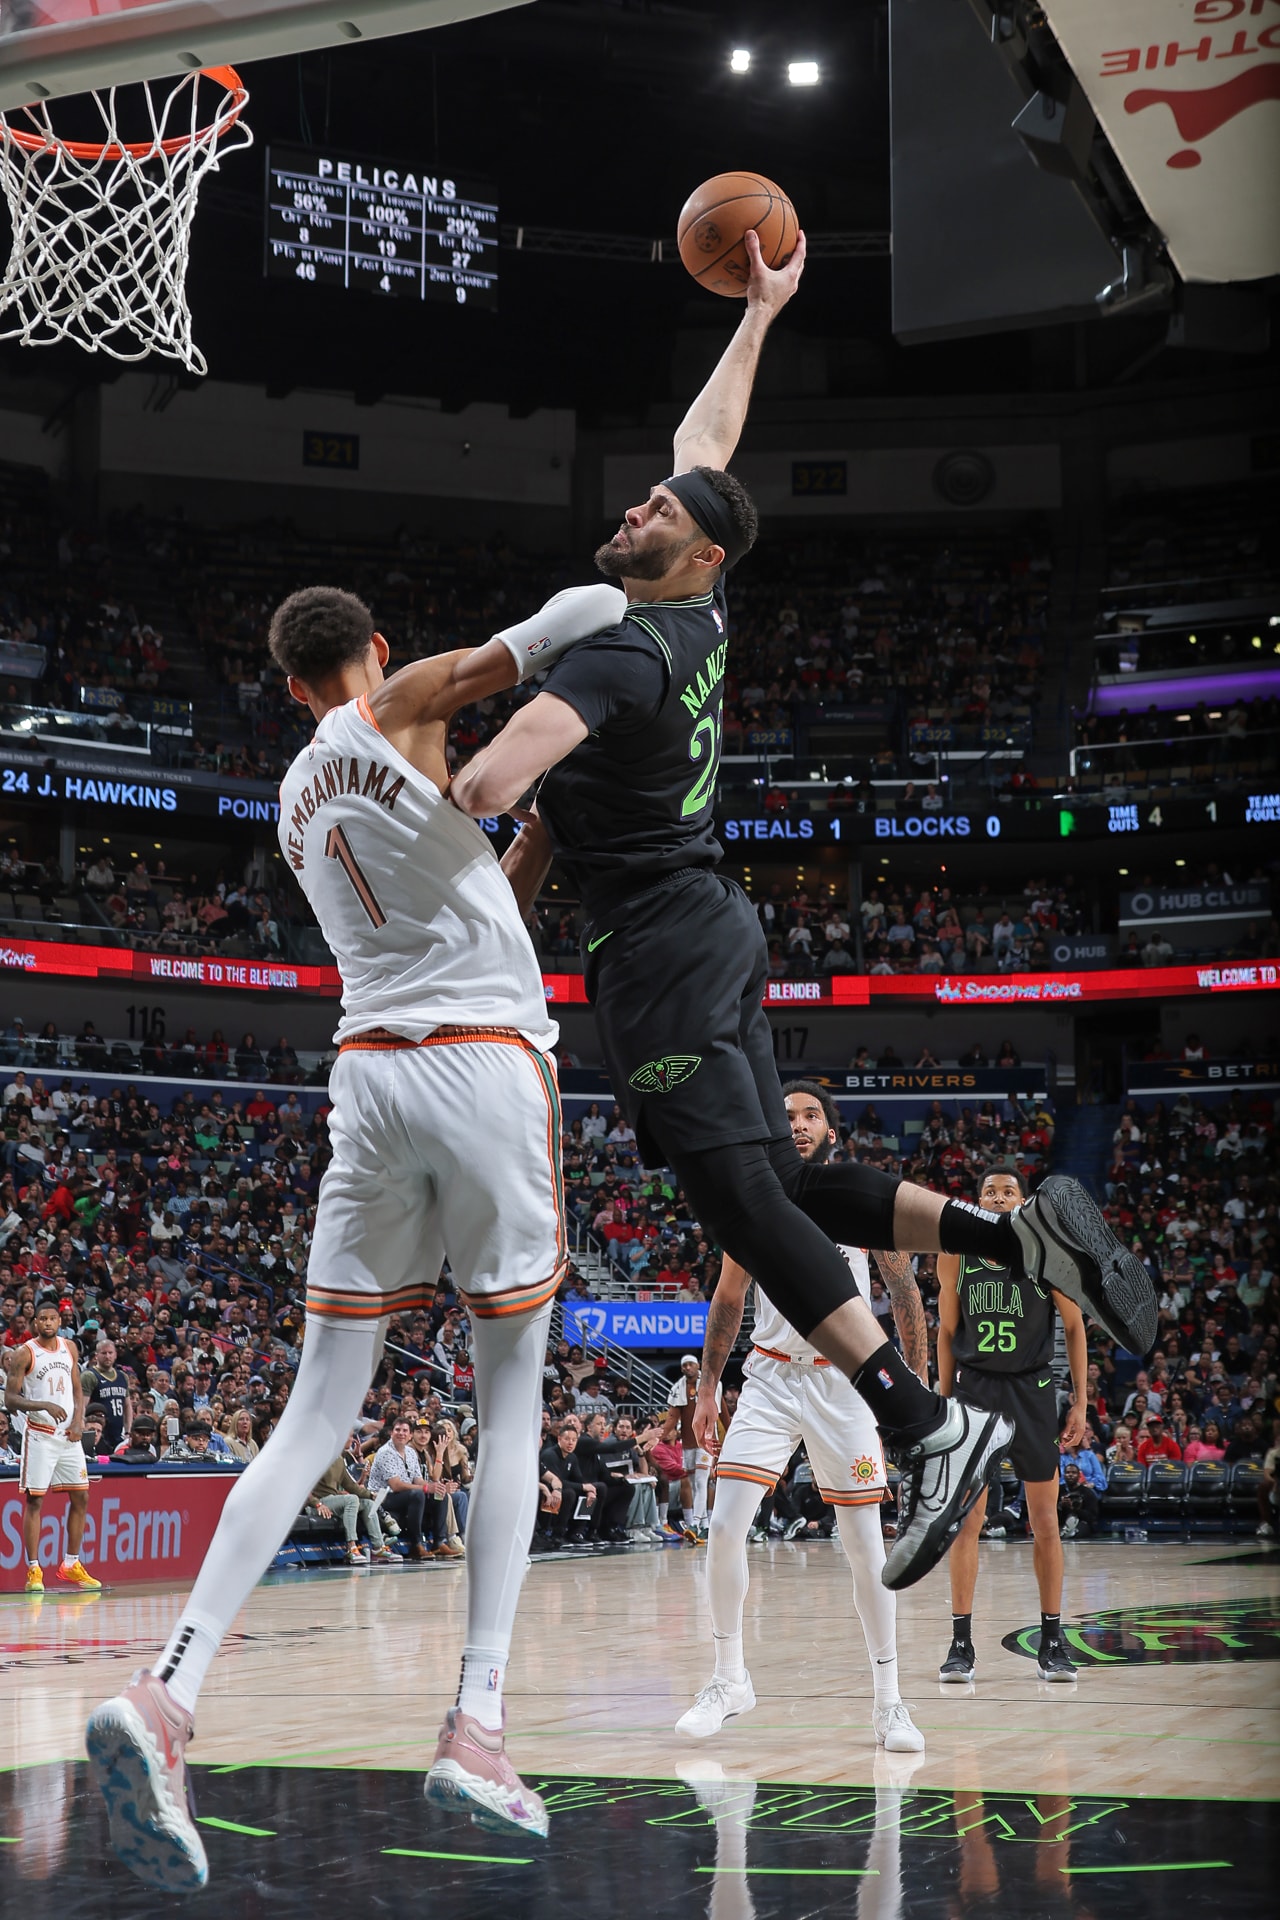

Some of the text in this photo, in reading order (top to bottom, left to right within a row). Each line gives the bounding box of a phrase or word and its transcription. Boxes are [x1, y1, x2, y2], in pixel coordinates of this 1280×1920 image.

[318, 159, 456, 199] PELICANS
[293, 192, 328, 213] 56%
[367, 205, 409, 226] 100%
[299, 227, 309, 244] 8
[446, 217, 479, 238] 29%
[378, 240, 397, 258] 19
[452, 251, 471, 269] 27
[295, 262, 317, 281] 46
[379, 275, 391, 293] 4
[455, 286, 466, 304] 9
[308, 437, 353, 464] 321
[794, 467, 844, 490] 322
[153, 701, 174, 714] 321
[751, 732, 778, 744] 322
[926, 729, 951, 741] 322
[163, 773, 193, 783] TICKETS
[2, 769, 178, 811] 24 J. HAWKINS
[288, 757, 407, 870] WEMBANYAMA
[1108, 805, 1139, 819] TIME
[1148, 806, 1163, 827] 4
[1206, 801, 1218, 823] 1
[724, 818, 841, 840] STEALS 1
[875, 815, 1001, 838] BLOCKS 0
[1108, 817, 1140, 832] OUTS
[323, 822, 389, 932] 1
[1160, 889, 1263, 910] HUB CLUB
[1075, 945, 1107, 959] HUB
[150, 958, 298, 989] WELCOME TO THE BLENDER
[1196, 966, 1277, 987] WELCOME TO
[768, 982, 821, 999] BLENDER
[126, 1005, 166, 1040] 116
[846, 1073, 976, 1089] BETRIVERS
[968, 1281, 1024, 1318] NOLA
[612, 1314, 708, 1335] FANDUE
[977, 1320, 1017, 1352] 25
[48, 1376, 65, 1396] 14
[110, 1399, 123, 1416] 15
[0, 1498, 182, 1570] Sate Farm
